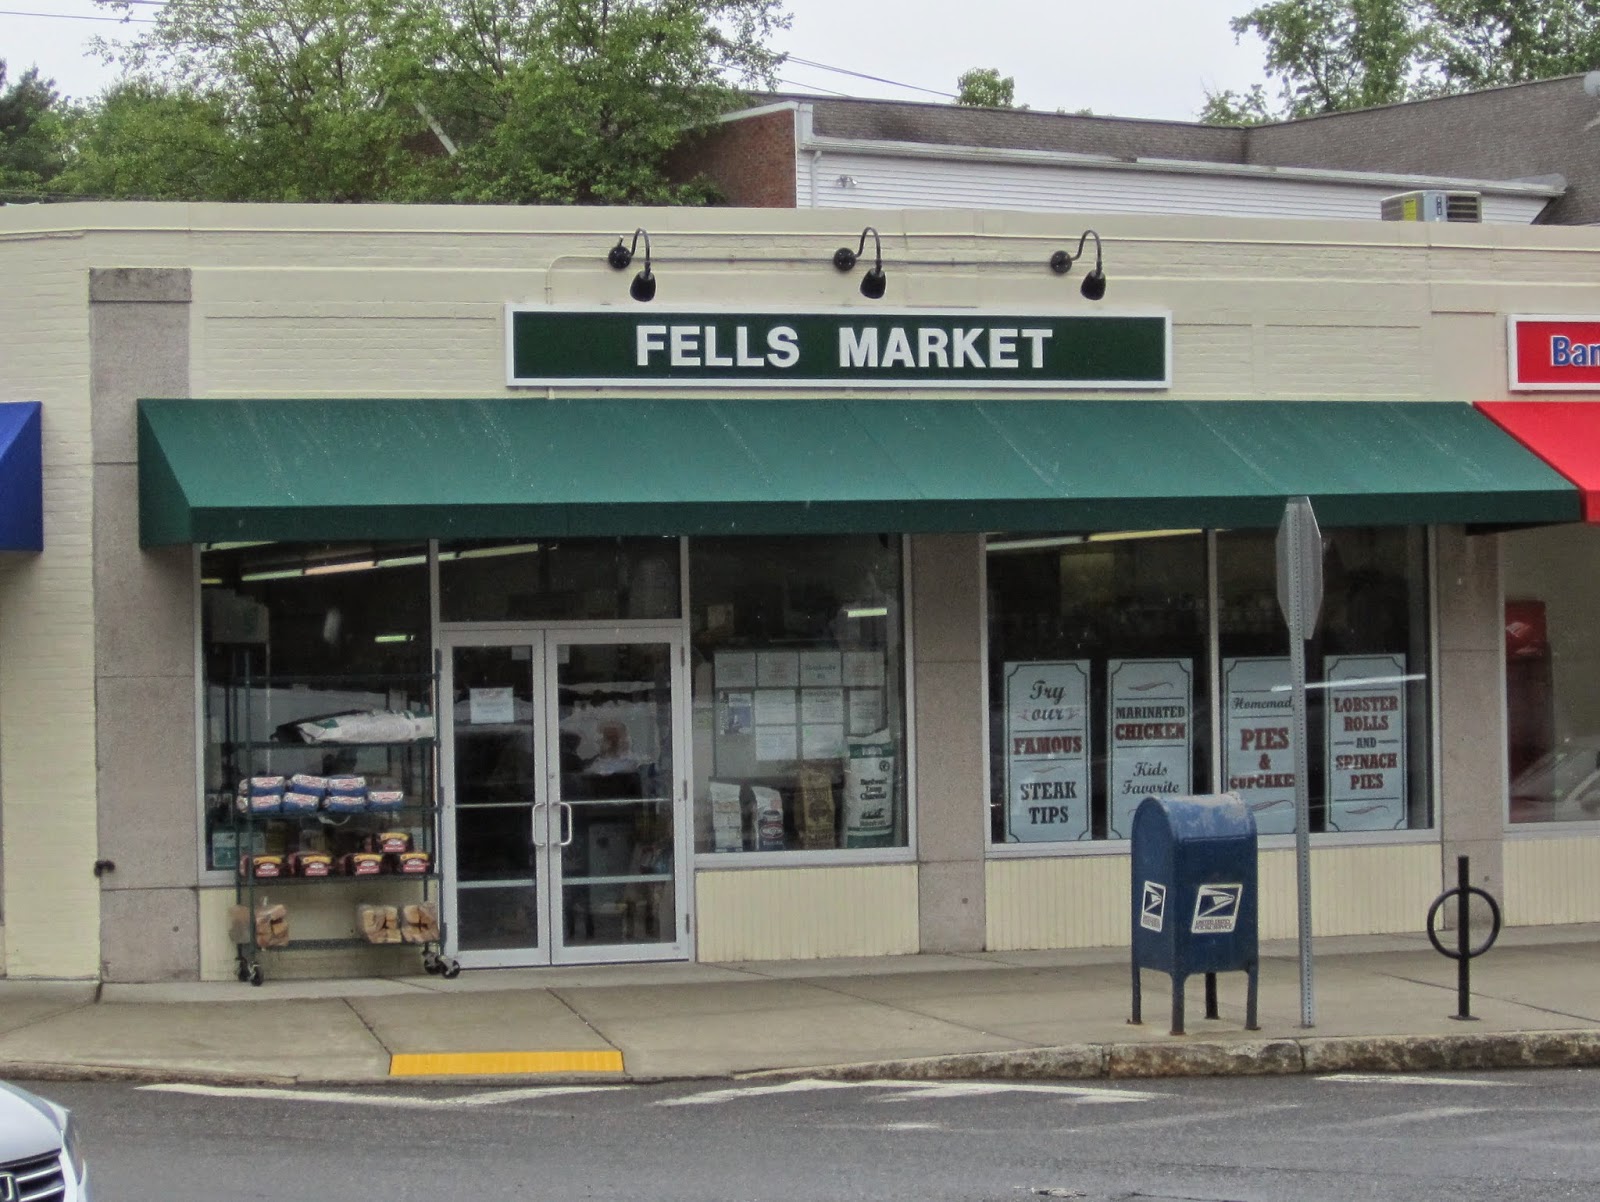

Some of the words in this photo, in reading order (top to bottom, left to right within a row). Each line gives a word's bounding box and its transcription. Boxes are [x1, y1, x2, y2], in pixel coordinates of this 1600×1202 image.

[636, 325, 800, 368] FELLS
[838, 327, 1054, 370] MARKET
[1030, 680, 1066, 705] Try
[1232, 696, 1295, 711] Homemad
[1333, 696, 1399, 713] LOBSTER
[1115, 706, 1185, 719] MARINATED
[1115, 723, 1186, 741] CHICKEN
[1343, 715, 1389, 732] ROLLS
[1013, 736, 1082, 755] FAMOUS
[1240, 727, 1289, 751] PIES
[1355, 737, 1377, 749] AND
[1132, 761, 1168, 777] Kids
[1257, 753, 1271, 770] &
[1335, 753, 1398, 770] SPINACH
[1122, 780, 1180, 795] Favorite
[1230, 773, 1295, 790] CUPCAKE
[1350, 773, 1384, 790] PIES
[1020, 782, 1077, 800] STEAK
[1028, 806, 1069, 824] TIPS
